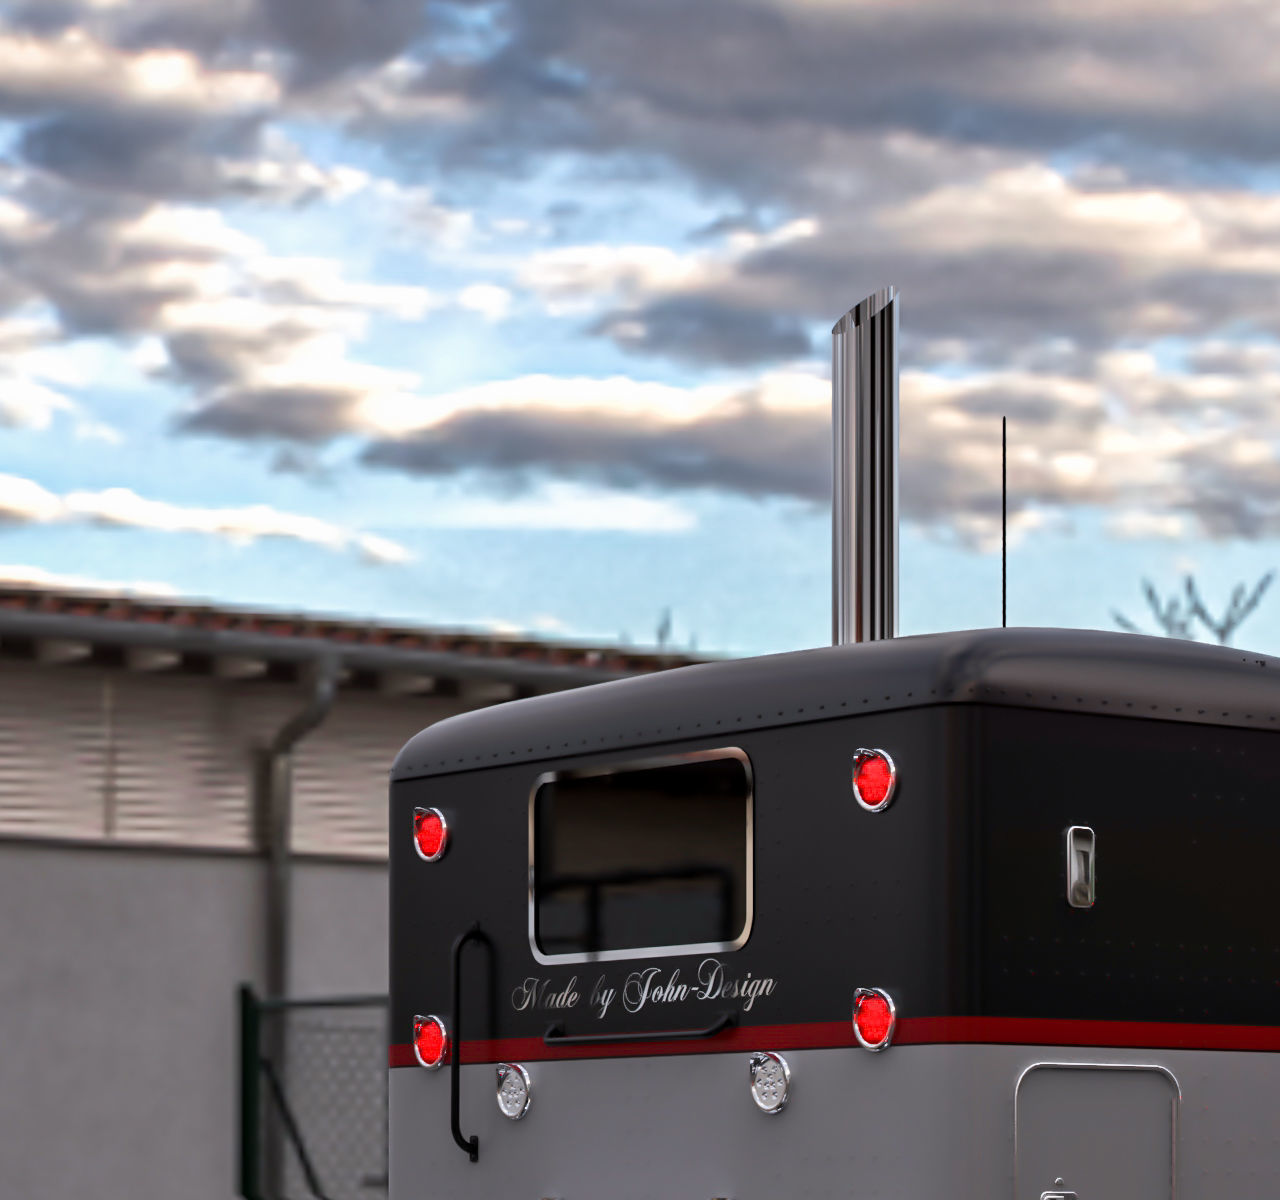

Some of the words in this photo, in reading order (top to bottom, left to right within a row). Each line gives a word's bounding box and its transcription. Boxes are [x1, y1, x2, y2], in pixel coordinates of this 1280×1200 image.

[511, 974, 581, 1011] Made
[589, 973, 617, 1019] by
[622, 957, 778, 1014] John-Design
